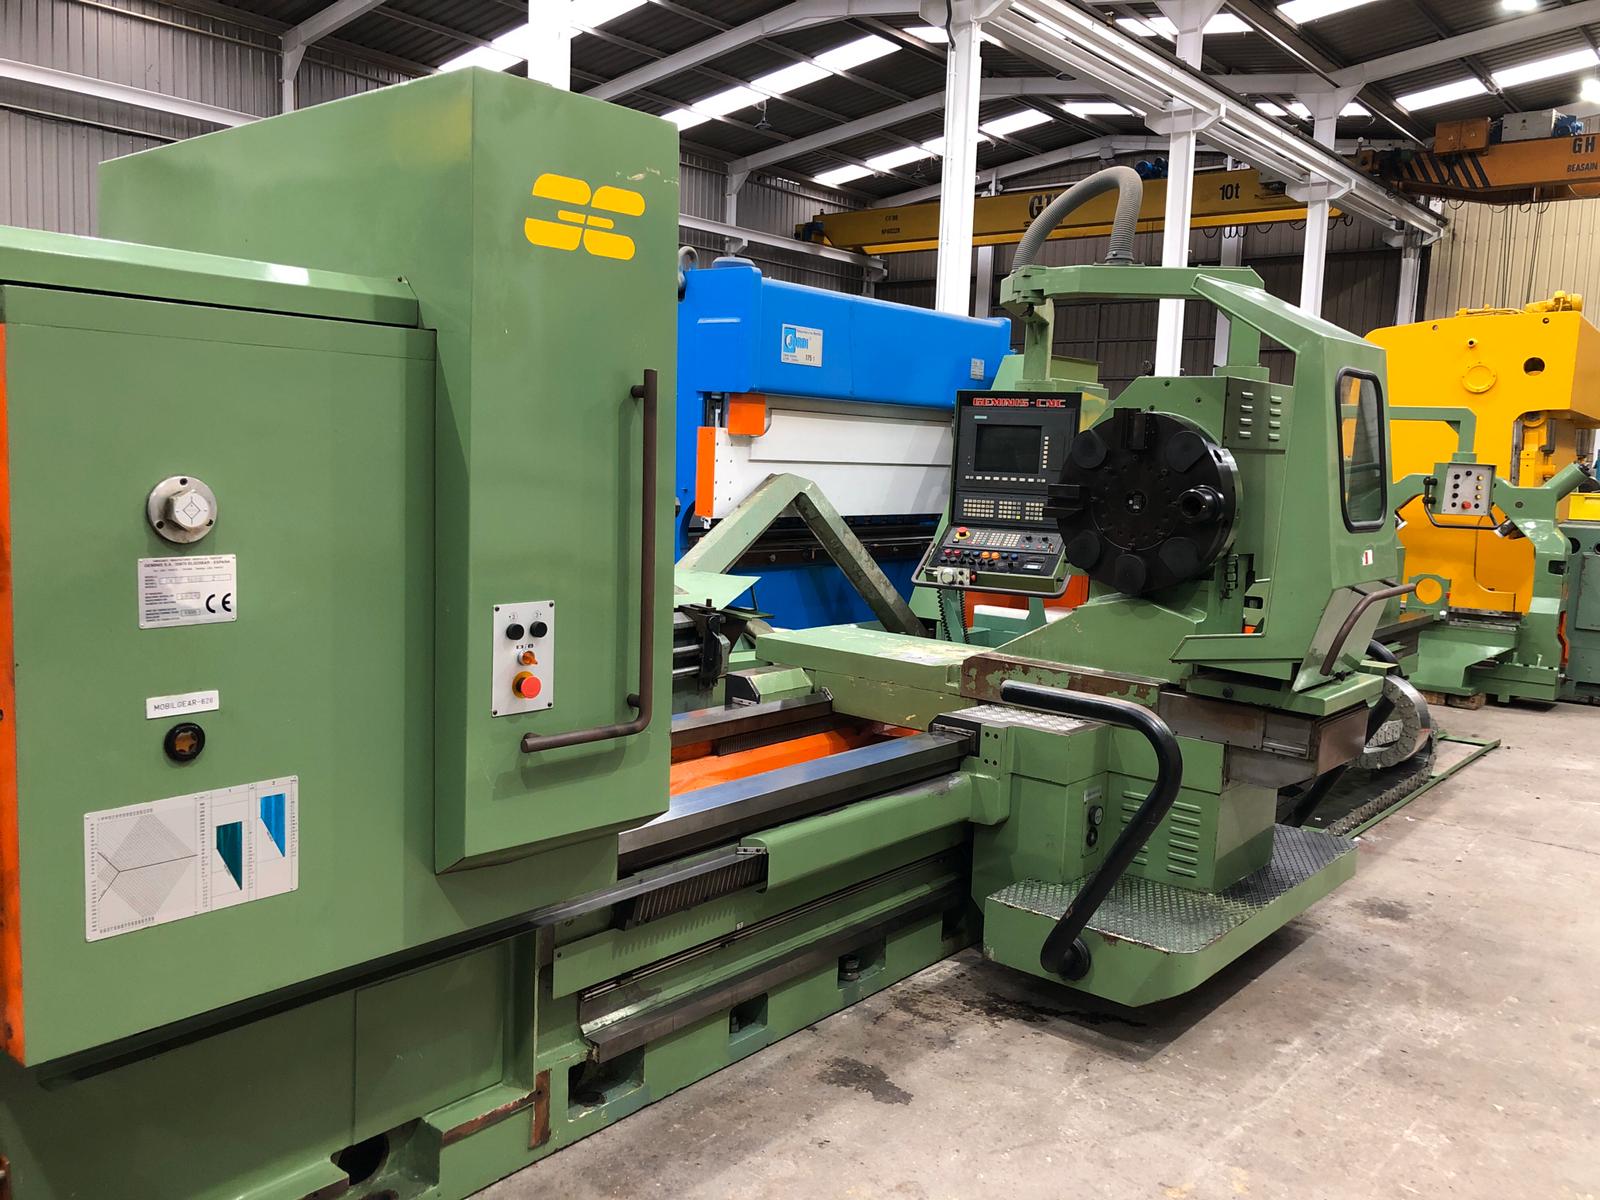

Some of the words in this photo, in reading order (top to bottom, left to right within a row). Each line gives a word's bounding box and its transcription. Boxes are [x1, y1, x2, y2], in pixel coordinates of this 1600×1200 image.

[1573, 136, 1595, 153] GH
[1567, 162, 1598, 172] BEASAIN
[1219, 183, 1240, 200] 10t
[972, 397, 1066, 408] GEMINIS-CNC
